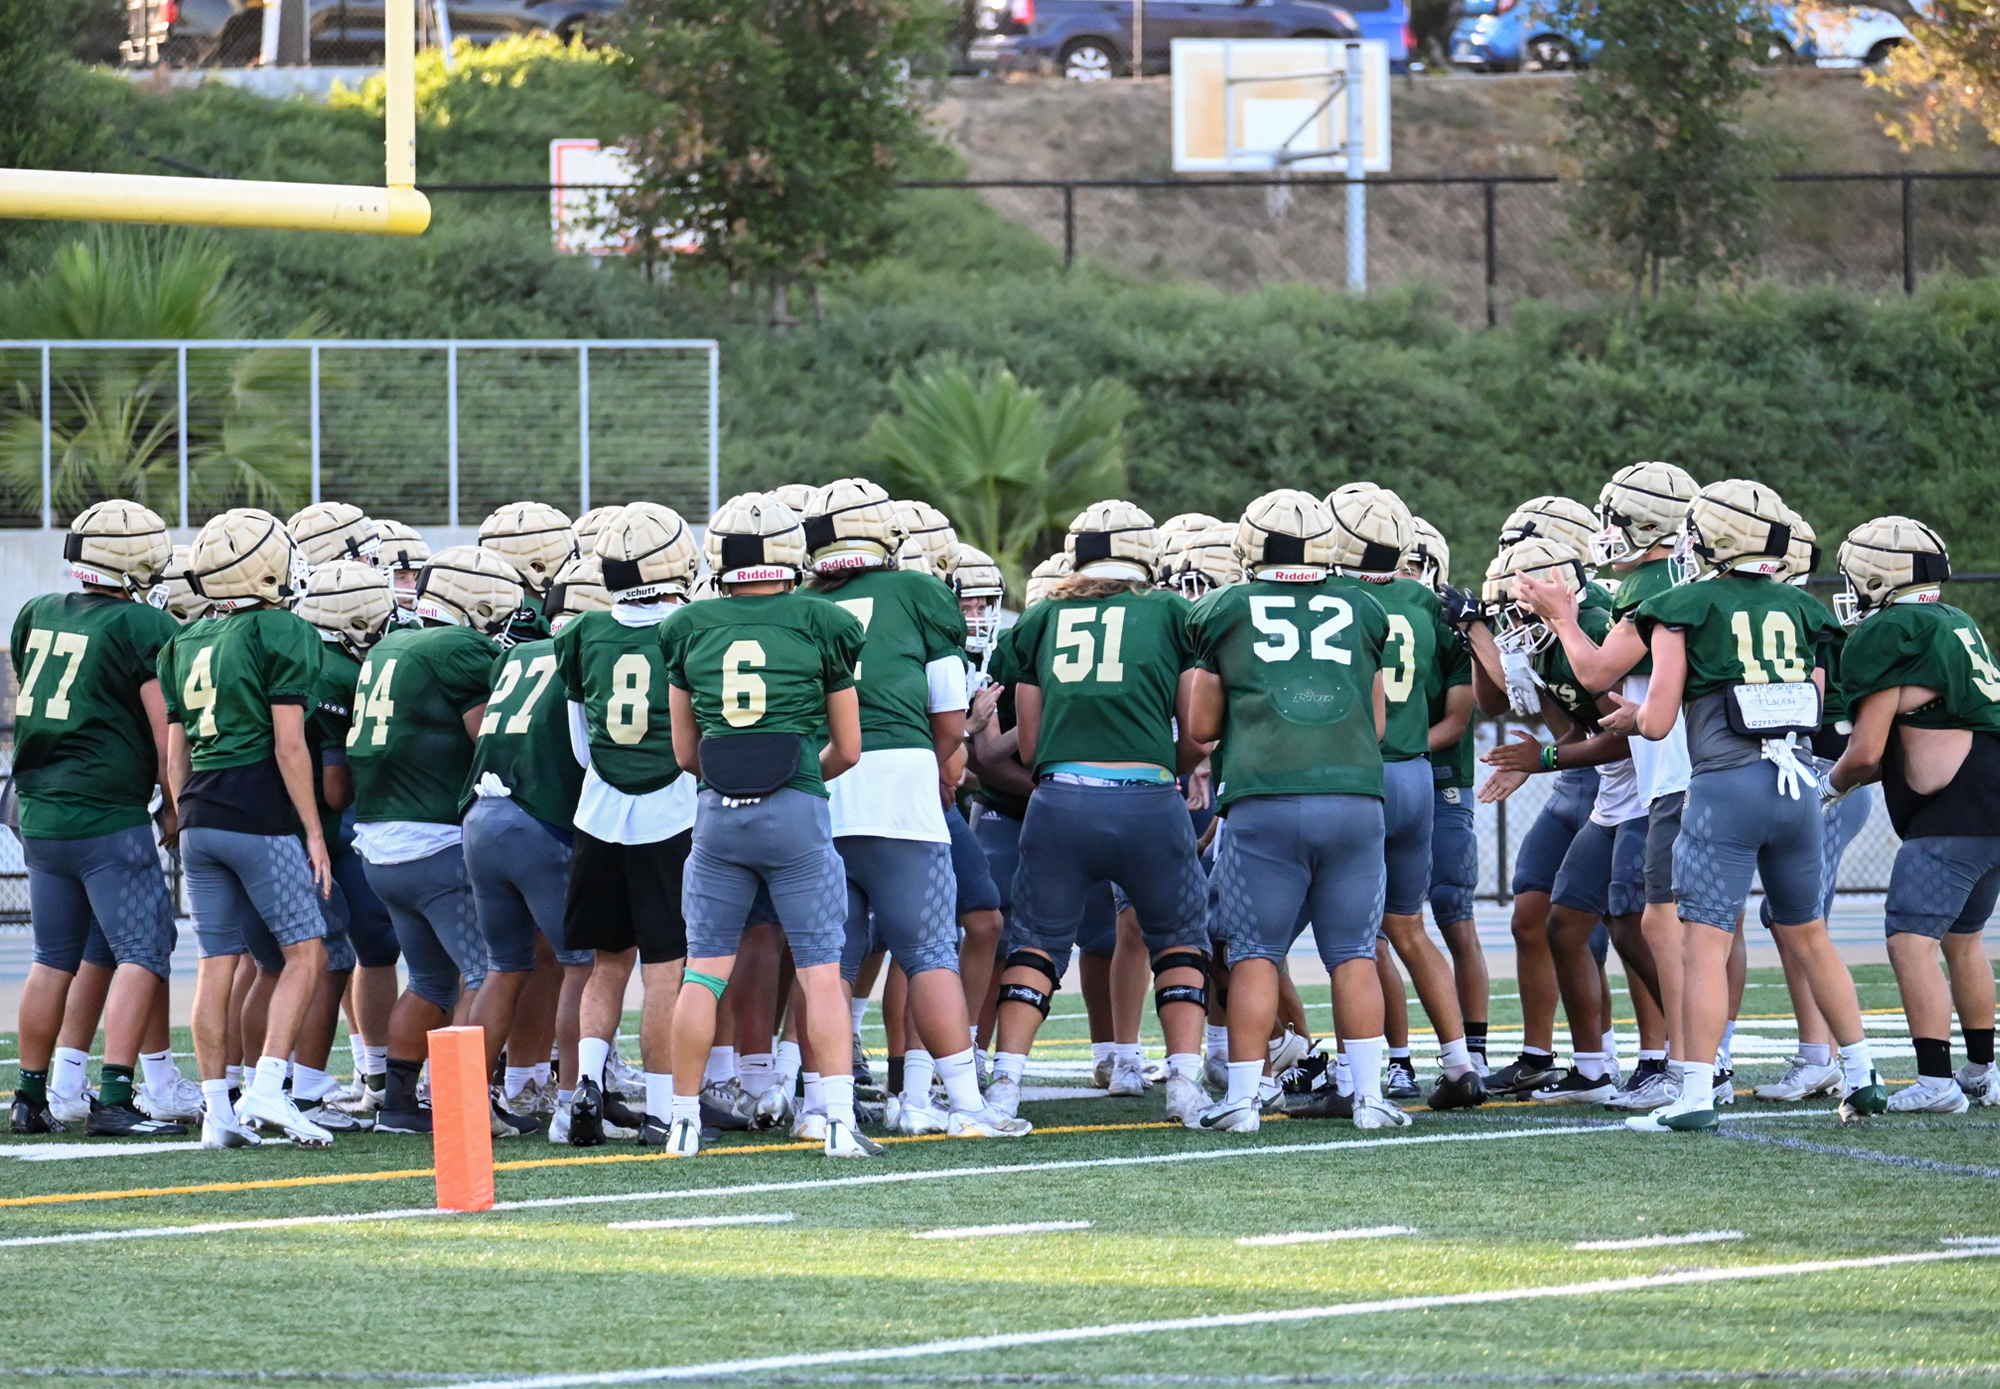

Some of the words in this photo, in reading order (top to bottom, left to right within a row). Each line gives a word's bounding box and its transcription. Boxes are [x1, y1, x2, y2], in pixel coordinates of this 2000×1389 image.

[625, 586, 657, 598] schutt
[737, 569, 783, 581] Riddell
[1275, 571, 1318, 581] Riddell
[1052, 606, 1126, 683] 51
[1249, 595, 1353, 665] 52
[1382, 614, 1415, 702] 3
[1731, 611, 1806, 683] 10
[15, 628, 89, 720] 77
[183, 646, 218, 737] 4
[477, 654, 558, 738] 27
[606, 654, 651, 745] 8
[721, 640, 767, 728] 6
